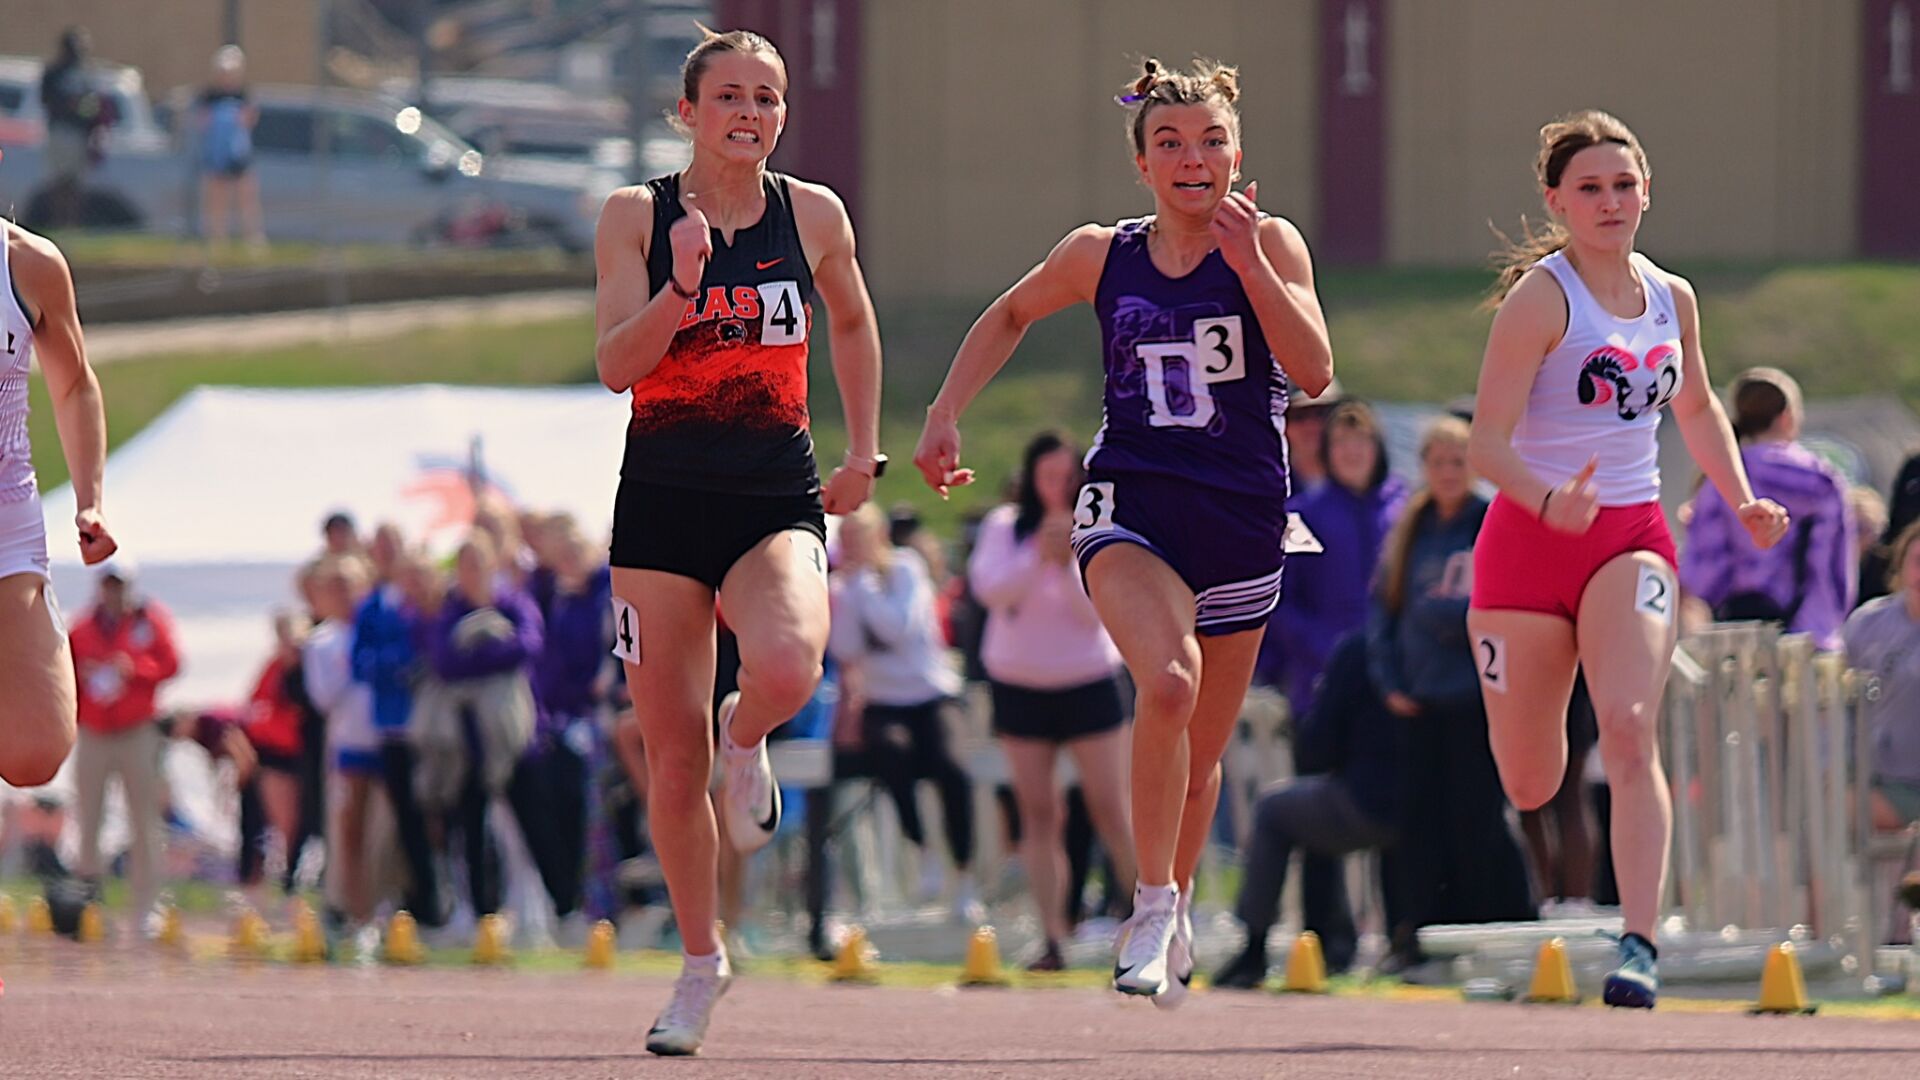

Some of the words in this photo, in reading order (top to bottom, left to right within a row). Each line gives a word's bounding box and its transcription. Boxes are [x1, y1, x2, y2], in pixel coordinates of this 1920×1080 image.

[770, 288, 798, 336] 4
[1204, 324, 1233, 374] 3
[1136, 341, 1216, 428] D
[1656, 365, 1677, 408] 2
[1078, 487, 1104, 530] 3
[1644, 574, 1666, 614] 2
[618, 606, 633, 653] 4
[1480, 638, 1498, 682] 2
